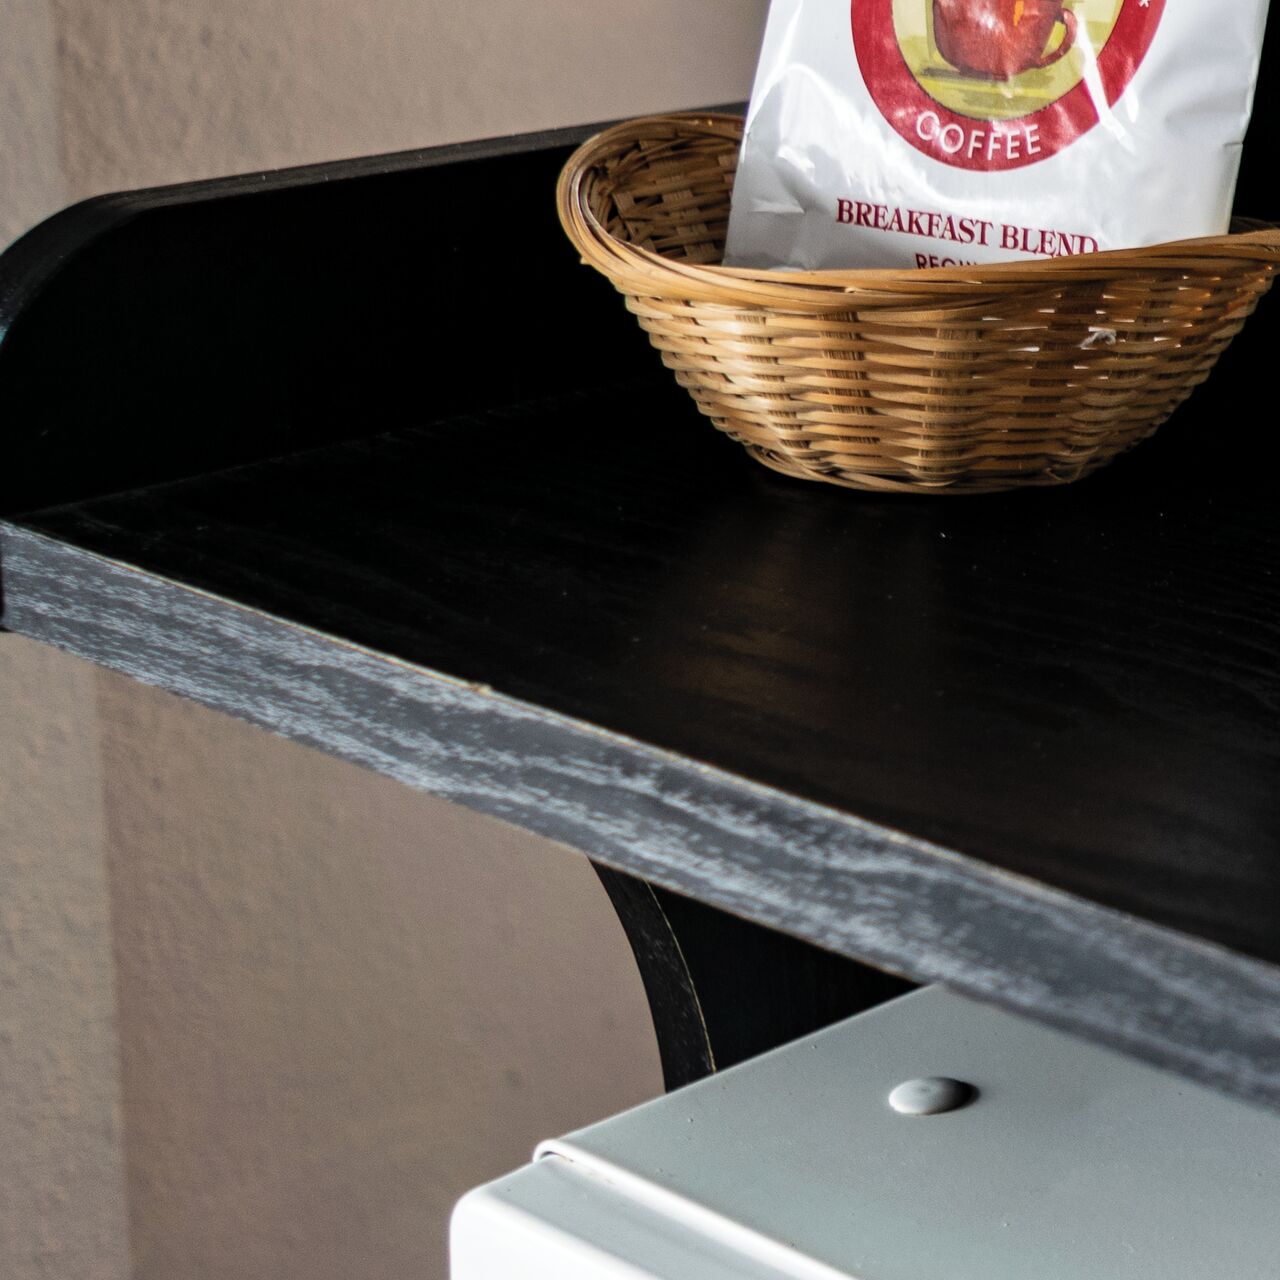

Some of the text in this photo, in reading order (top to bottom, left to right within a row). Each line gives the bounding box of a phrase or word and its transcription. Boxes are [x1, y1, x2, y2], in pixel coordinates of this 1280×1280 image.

[914, 108, 1043, 161] COFFEE
[834, 197, 1100, 258] BREAKFAST BLEND
